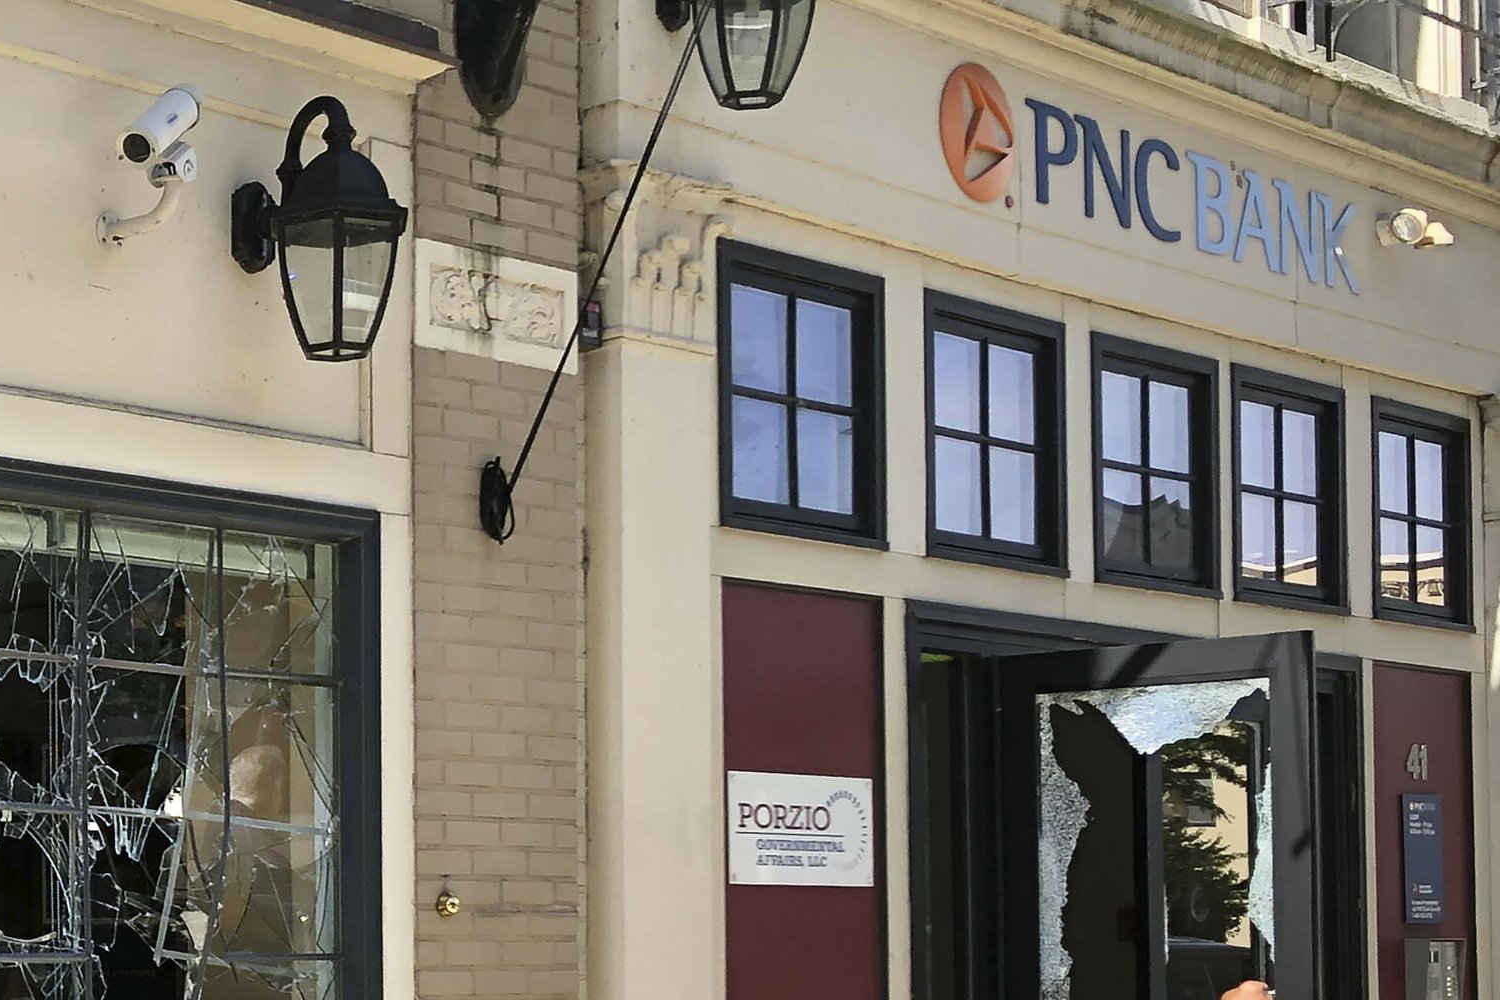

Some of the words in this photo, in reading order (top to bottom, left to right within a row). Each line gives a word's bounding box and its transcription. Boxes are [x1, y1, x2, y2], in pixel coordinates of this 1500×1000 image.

[1025, 97, 1182, 243] PNC
[1185, 150, 1360, 296] BANK
[1406, 743, 1428, 781] 41
[738, 803, 832, 831] PORZIO
[755, 839, 845, 852] GOVERNMENTAL
[808, 856, 828, 867] LLC
